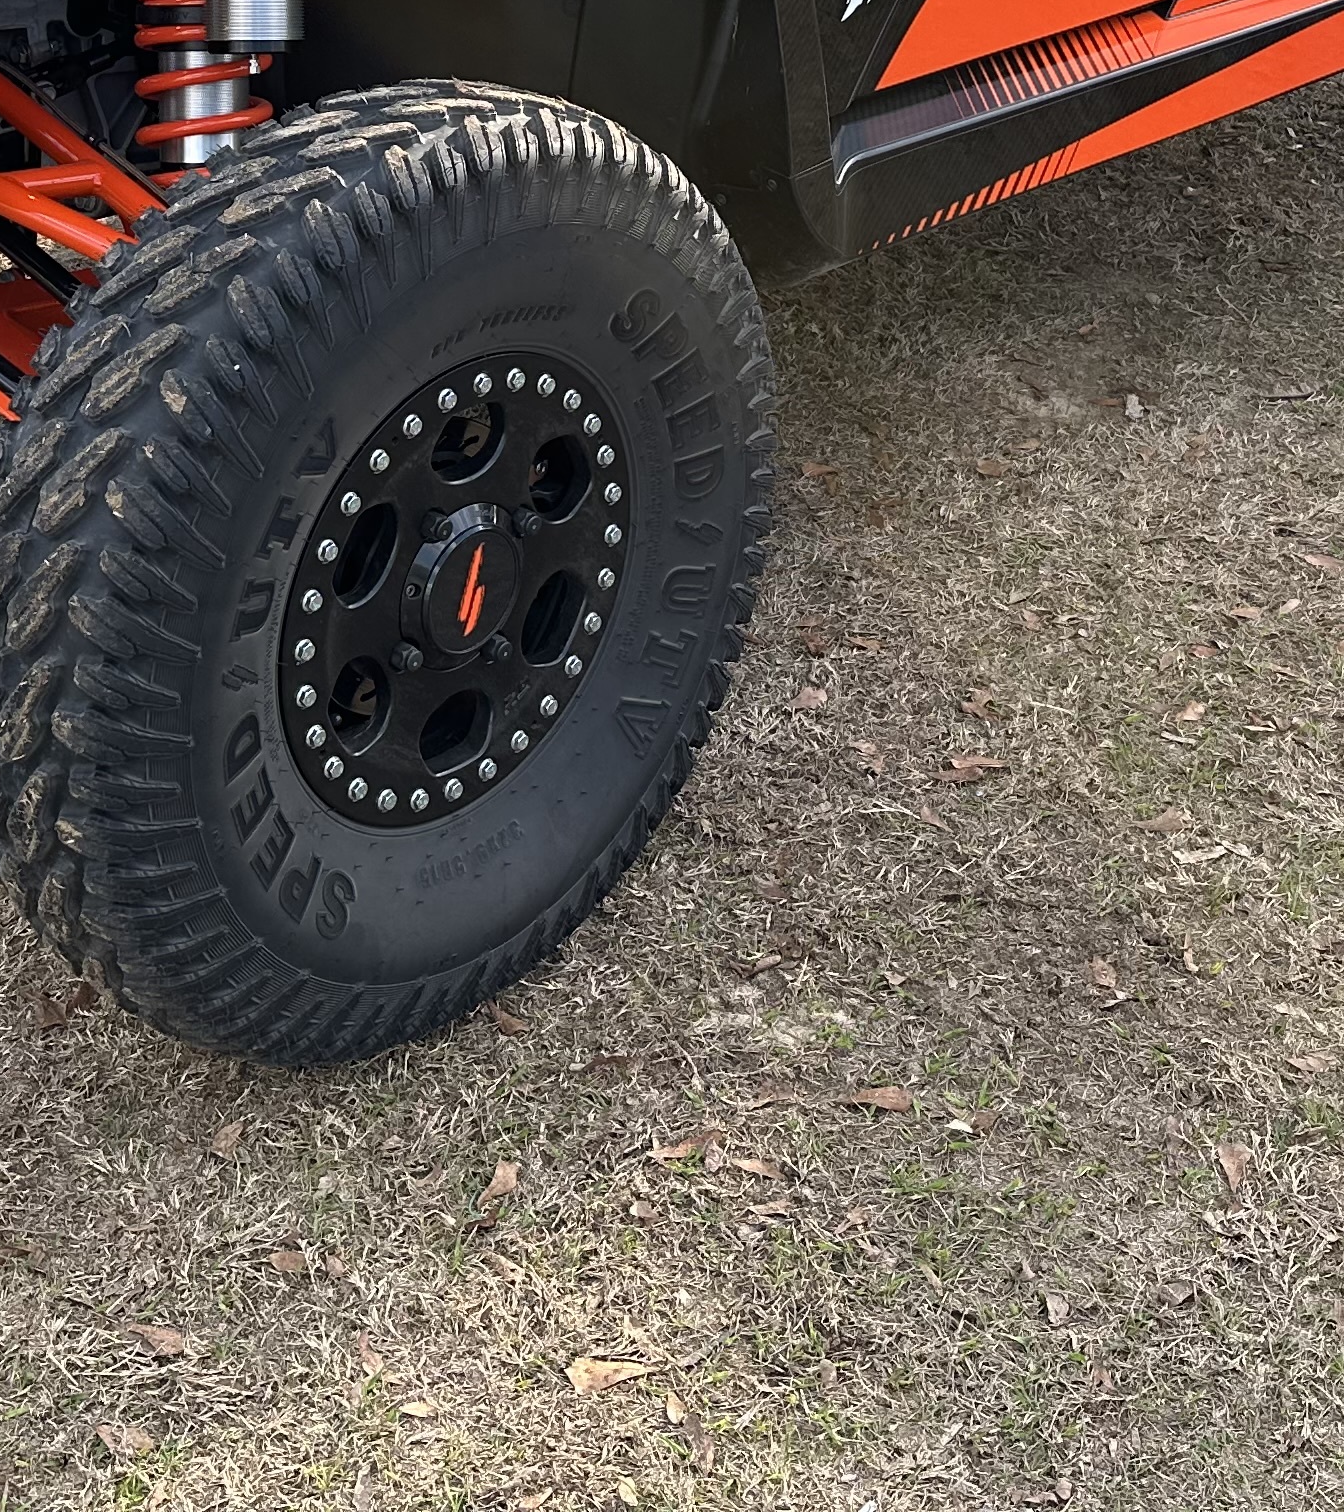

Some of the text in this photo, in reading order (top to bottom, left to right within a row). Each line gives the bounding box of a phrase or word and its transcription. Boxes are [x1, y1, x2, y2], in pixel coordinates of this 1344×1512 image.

[223, 414, 358, 942] SPEED UTV
[608, 287, 725, 760] SPEED UTV
